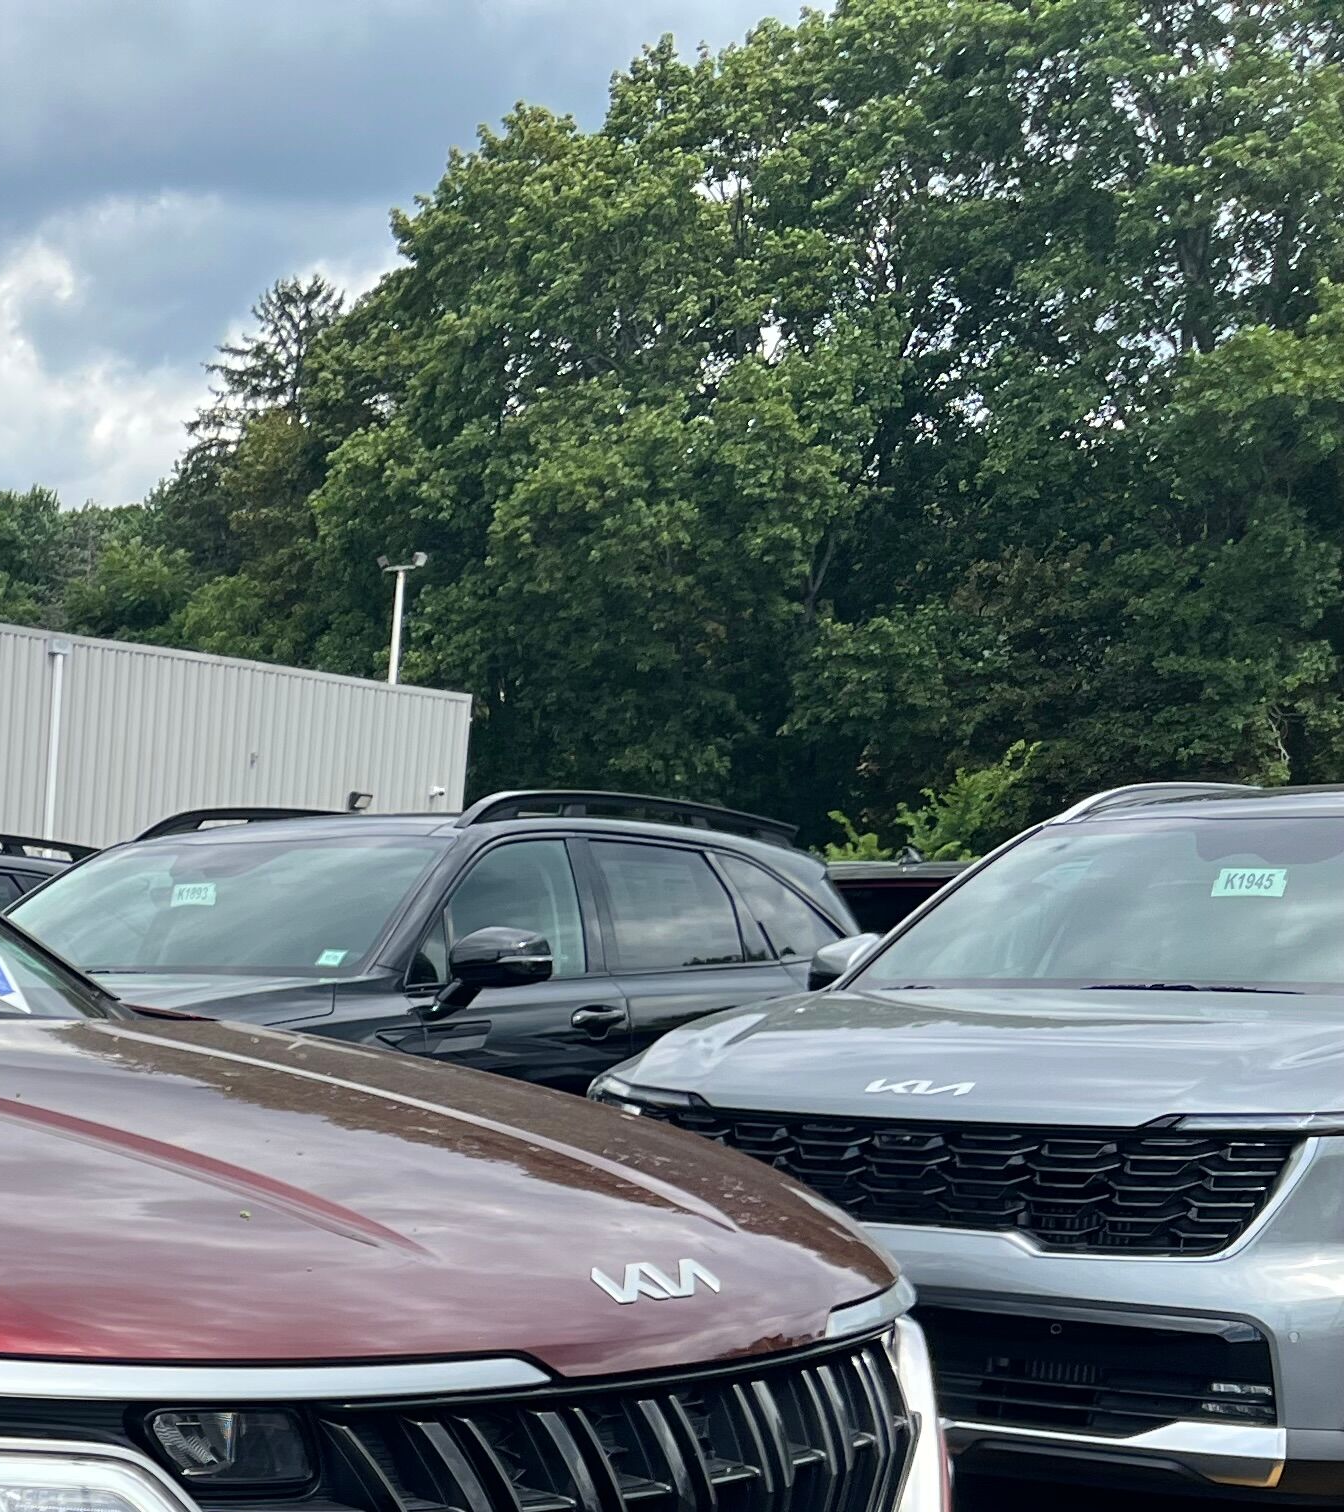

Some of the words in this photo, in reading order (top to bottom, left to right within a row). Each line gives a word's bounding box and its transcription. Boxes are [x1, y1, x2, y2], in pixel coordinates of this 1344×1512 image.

[1224, 872, 1275, 890] K1945
[864, 1078, 976, 1097] KIA
[590, 1258, 721, 1305] KIA
